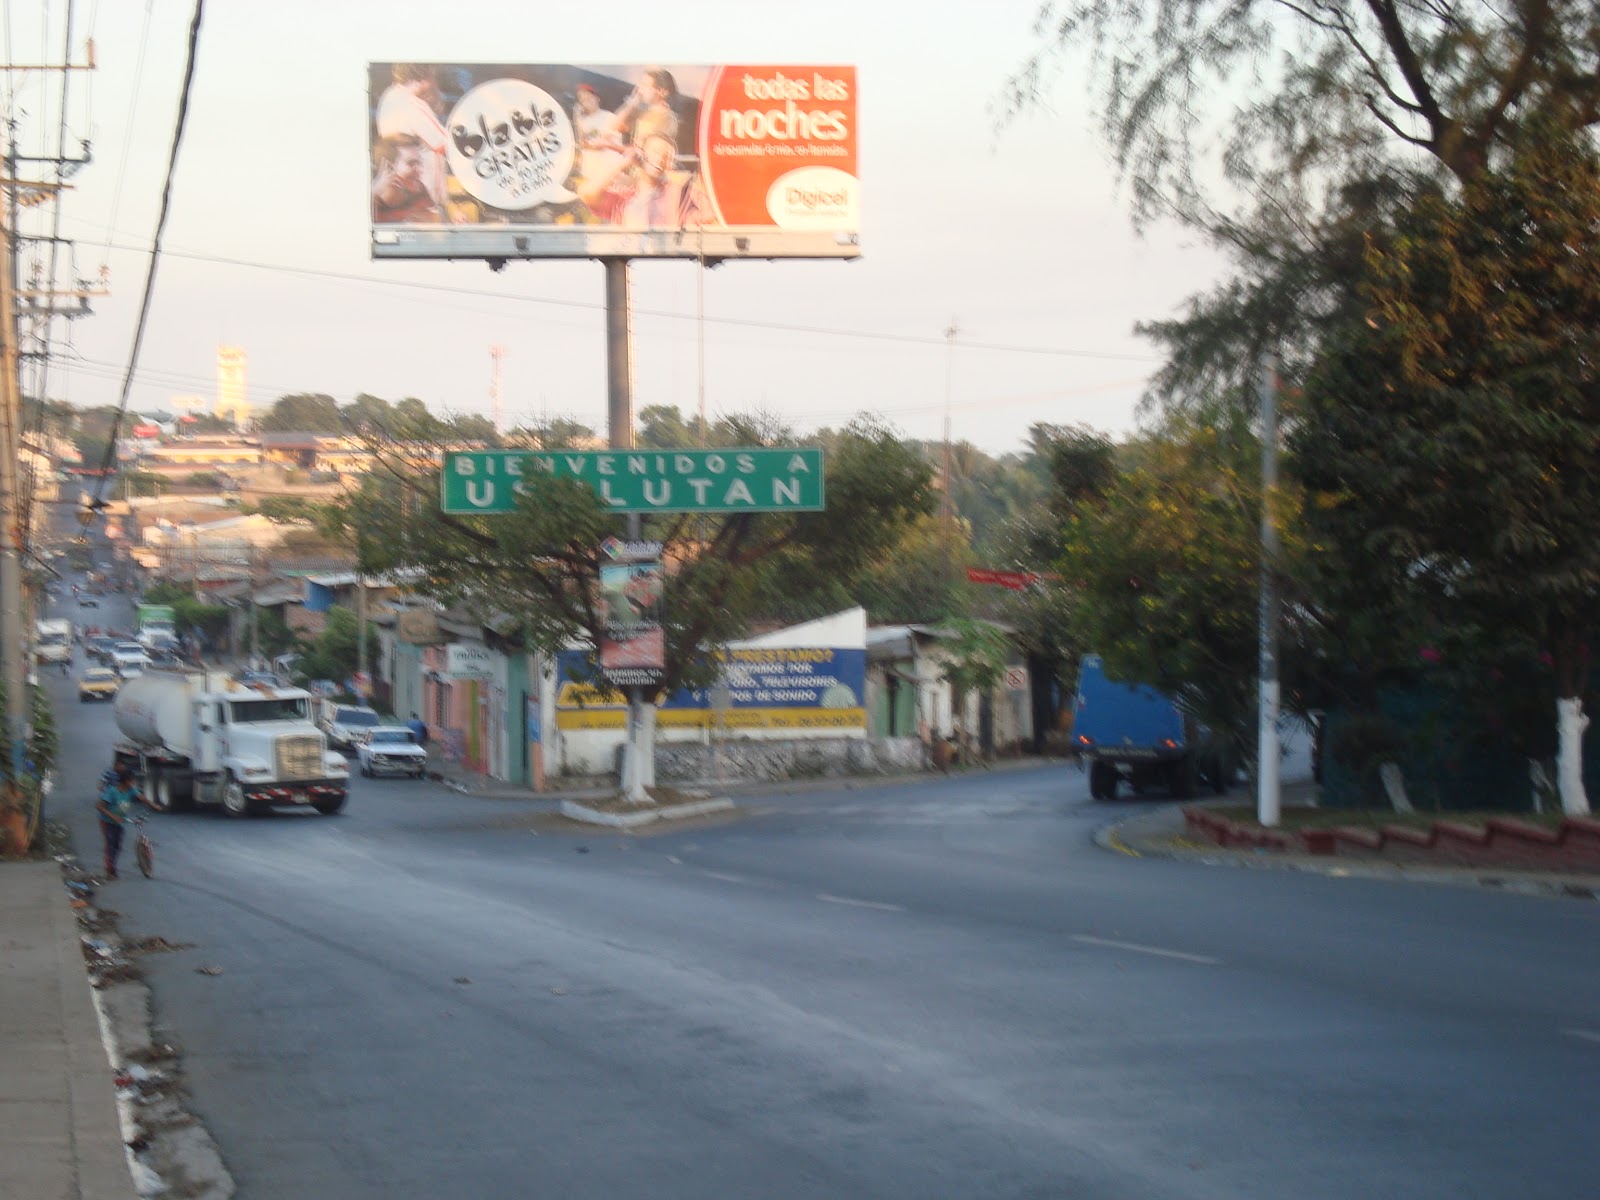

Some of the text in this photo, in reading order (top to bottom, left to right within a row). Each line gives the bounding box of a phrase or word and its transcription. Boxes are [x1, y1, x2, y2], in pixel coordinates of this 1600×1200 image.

[742, 71, 848, 101] todas las
[720, 99, 848, 140] noches
[475, 131, 562, 179] GRATIS
[784, 187, 848, 210] Digicel
[454, 453, 810, 476] BIENVENIDOS A
[465, 477, 800, 508] USLUTAN
[787, 661, 813, 675] POR
[762, 675, 838, 689] TELEVISORES
[755, 689, 772, 702] DE
[772, 689, 817, 702] SONIDO
